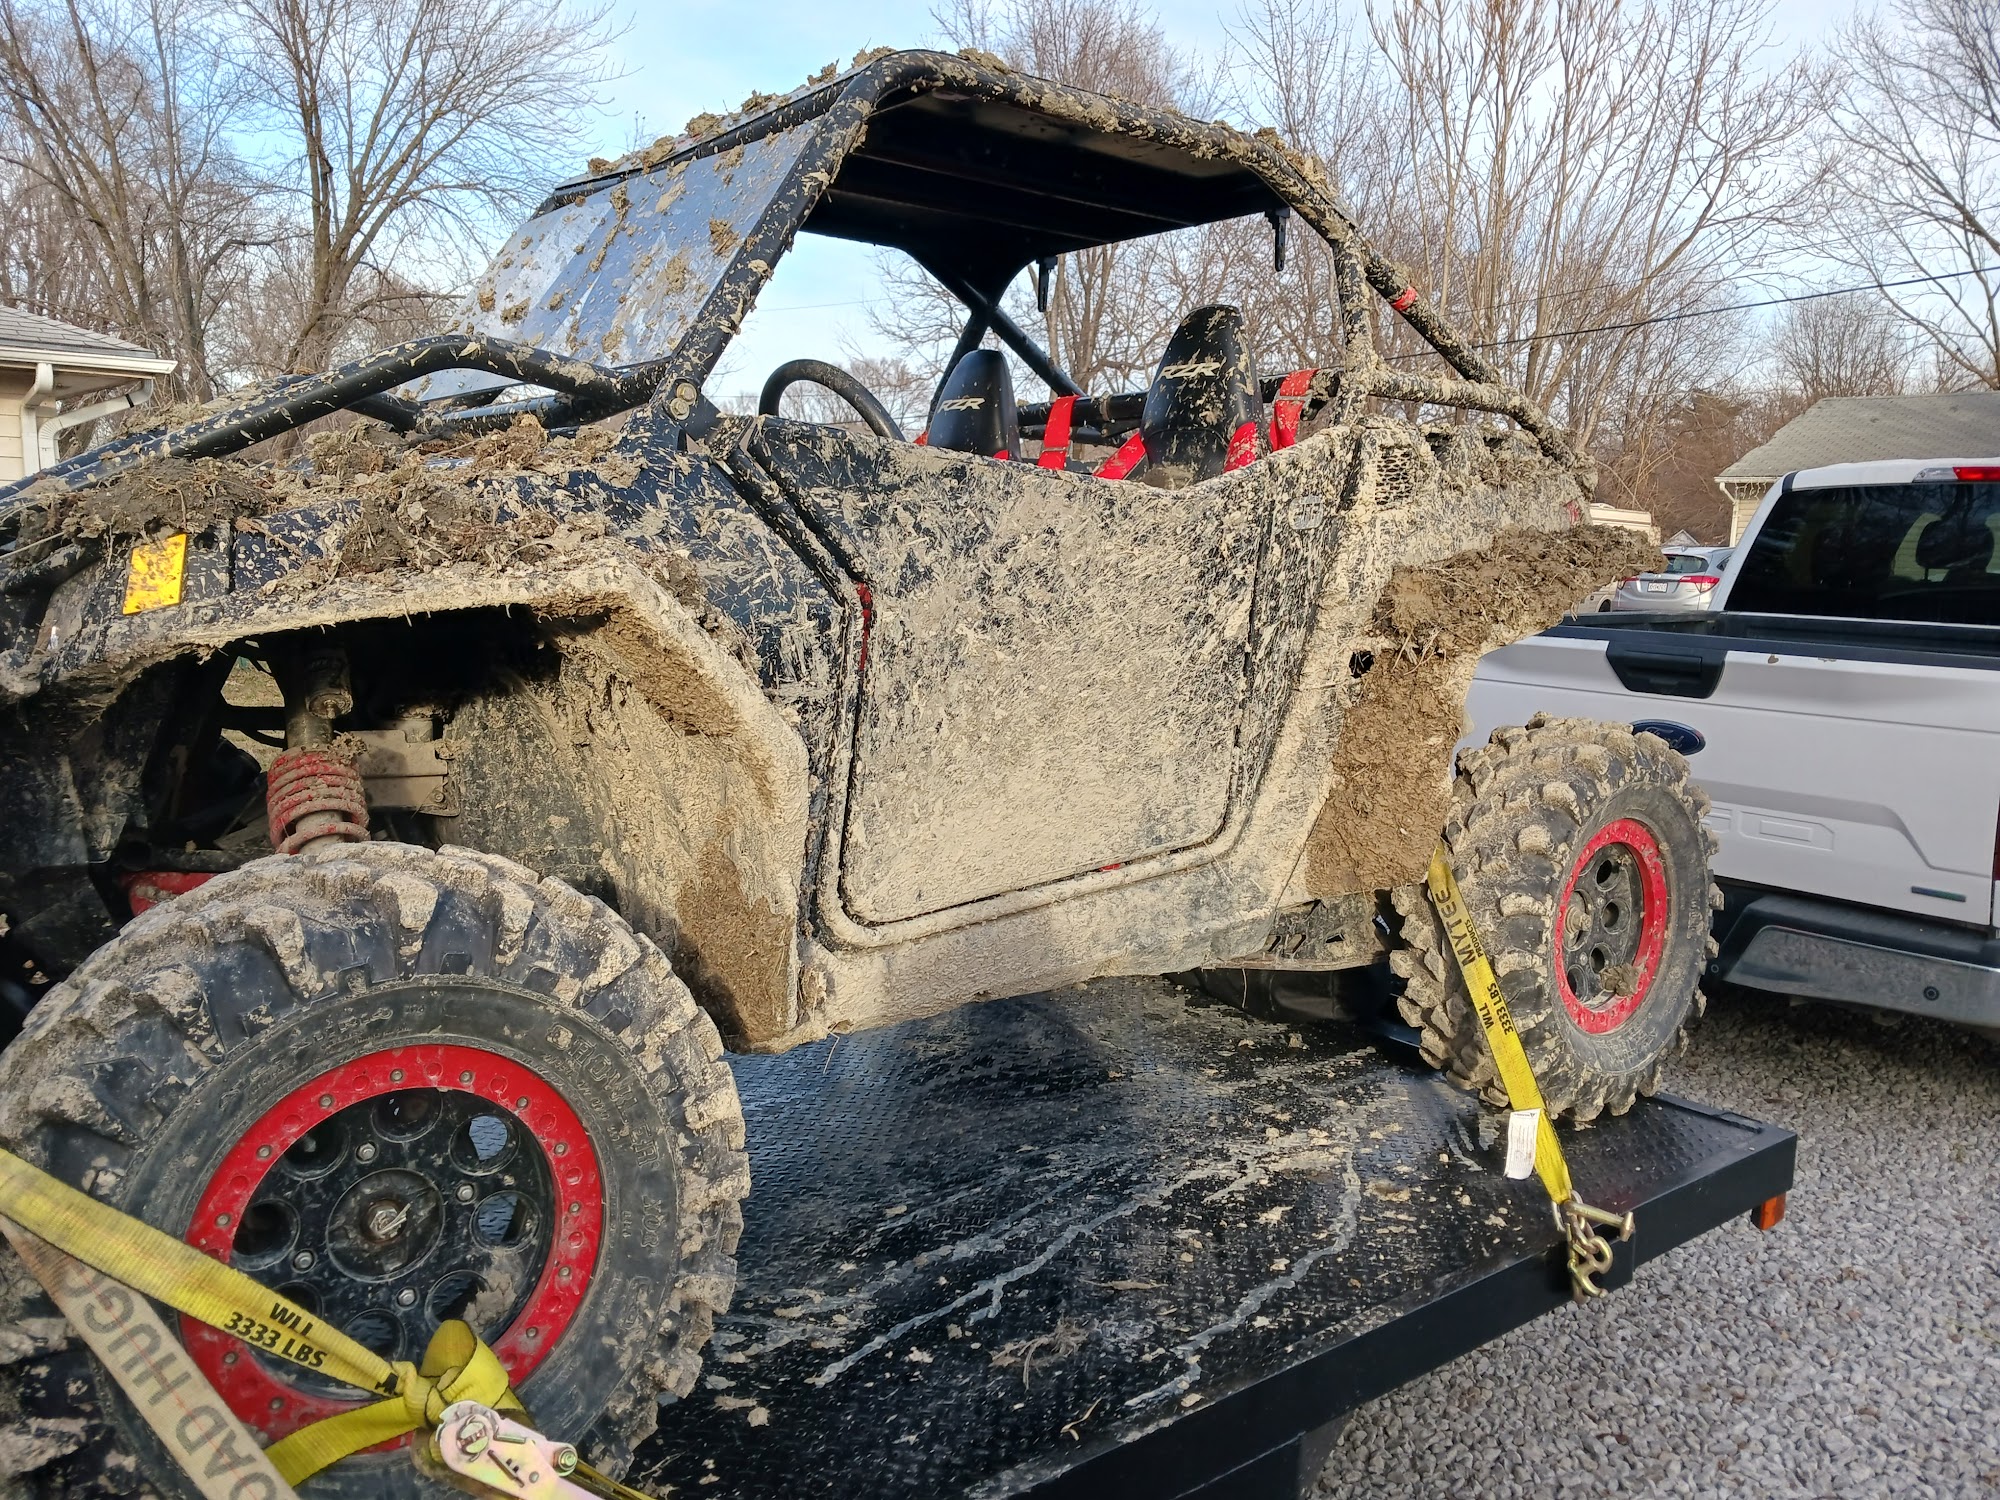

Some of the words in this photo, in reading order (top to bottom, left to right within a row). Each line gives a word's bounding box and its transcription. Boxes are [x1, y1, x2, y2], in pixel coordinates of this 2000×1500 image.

[1158, 361, 1222, 381] RZR
[937, 396, 985, 413] RZR
[1435, 887, 1476, 967] MYTEE
[1464, 919, 1484, 958] PRODUCTS
[1487, 982, 1502, 1006] LBS
[1478, 1002, 1495, 1030] WLL
[1496, 1007, 1514, 1036] 3333
[224, 1312, 281, 1348] 3333
[281, 1338, 328, 1368] LBS
